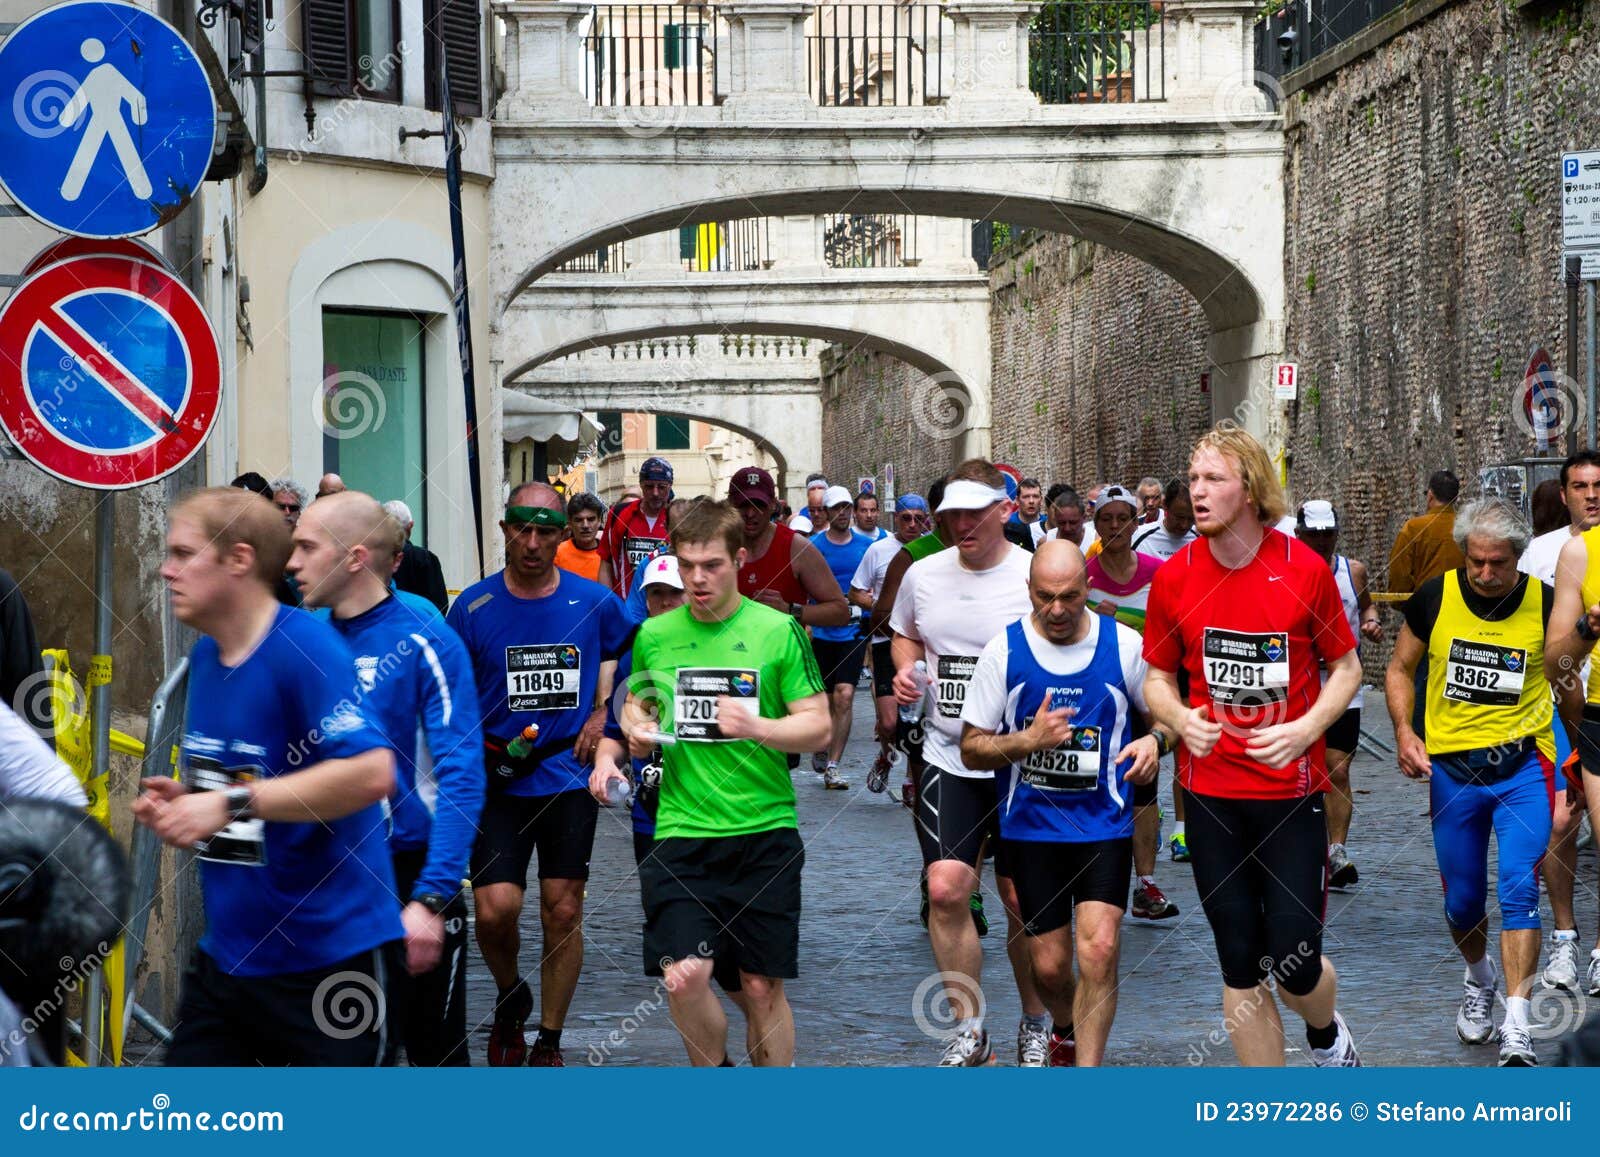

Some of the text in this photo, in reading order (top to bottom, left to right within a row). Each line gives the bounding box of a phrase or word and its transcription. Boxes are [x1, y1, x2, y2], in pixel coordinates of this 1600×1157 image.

[1567, 161, 1576, 176] P
[523, 653, 557, 662] MARATONA
[1465, 648, 1499, 658] MARATONA
[1471, 656, 1489, 664] ROMA
[1209, 661, 1265, 687] 12991
[1454, 665, 1500, 690] 8362
[513, 672, 564, 693] 11849
